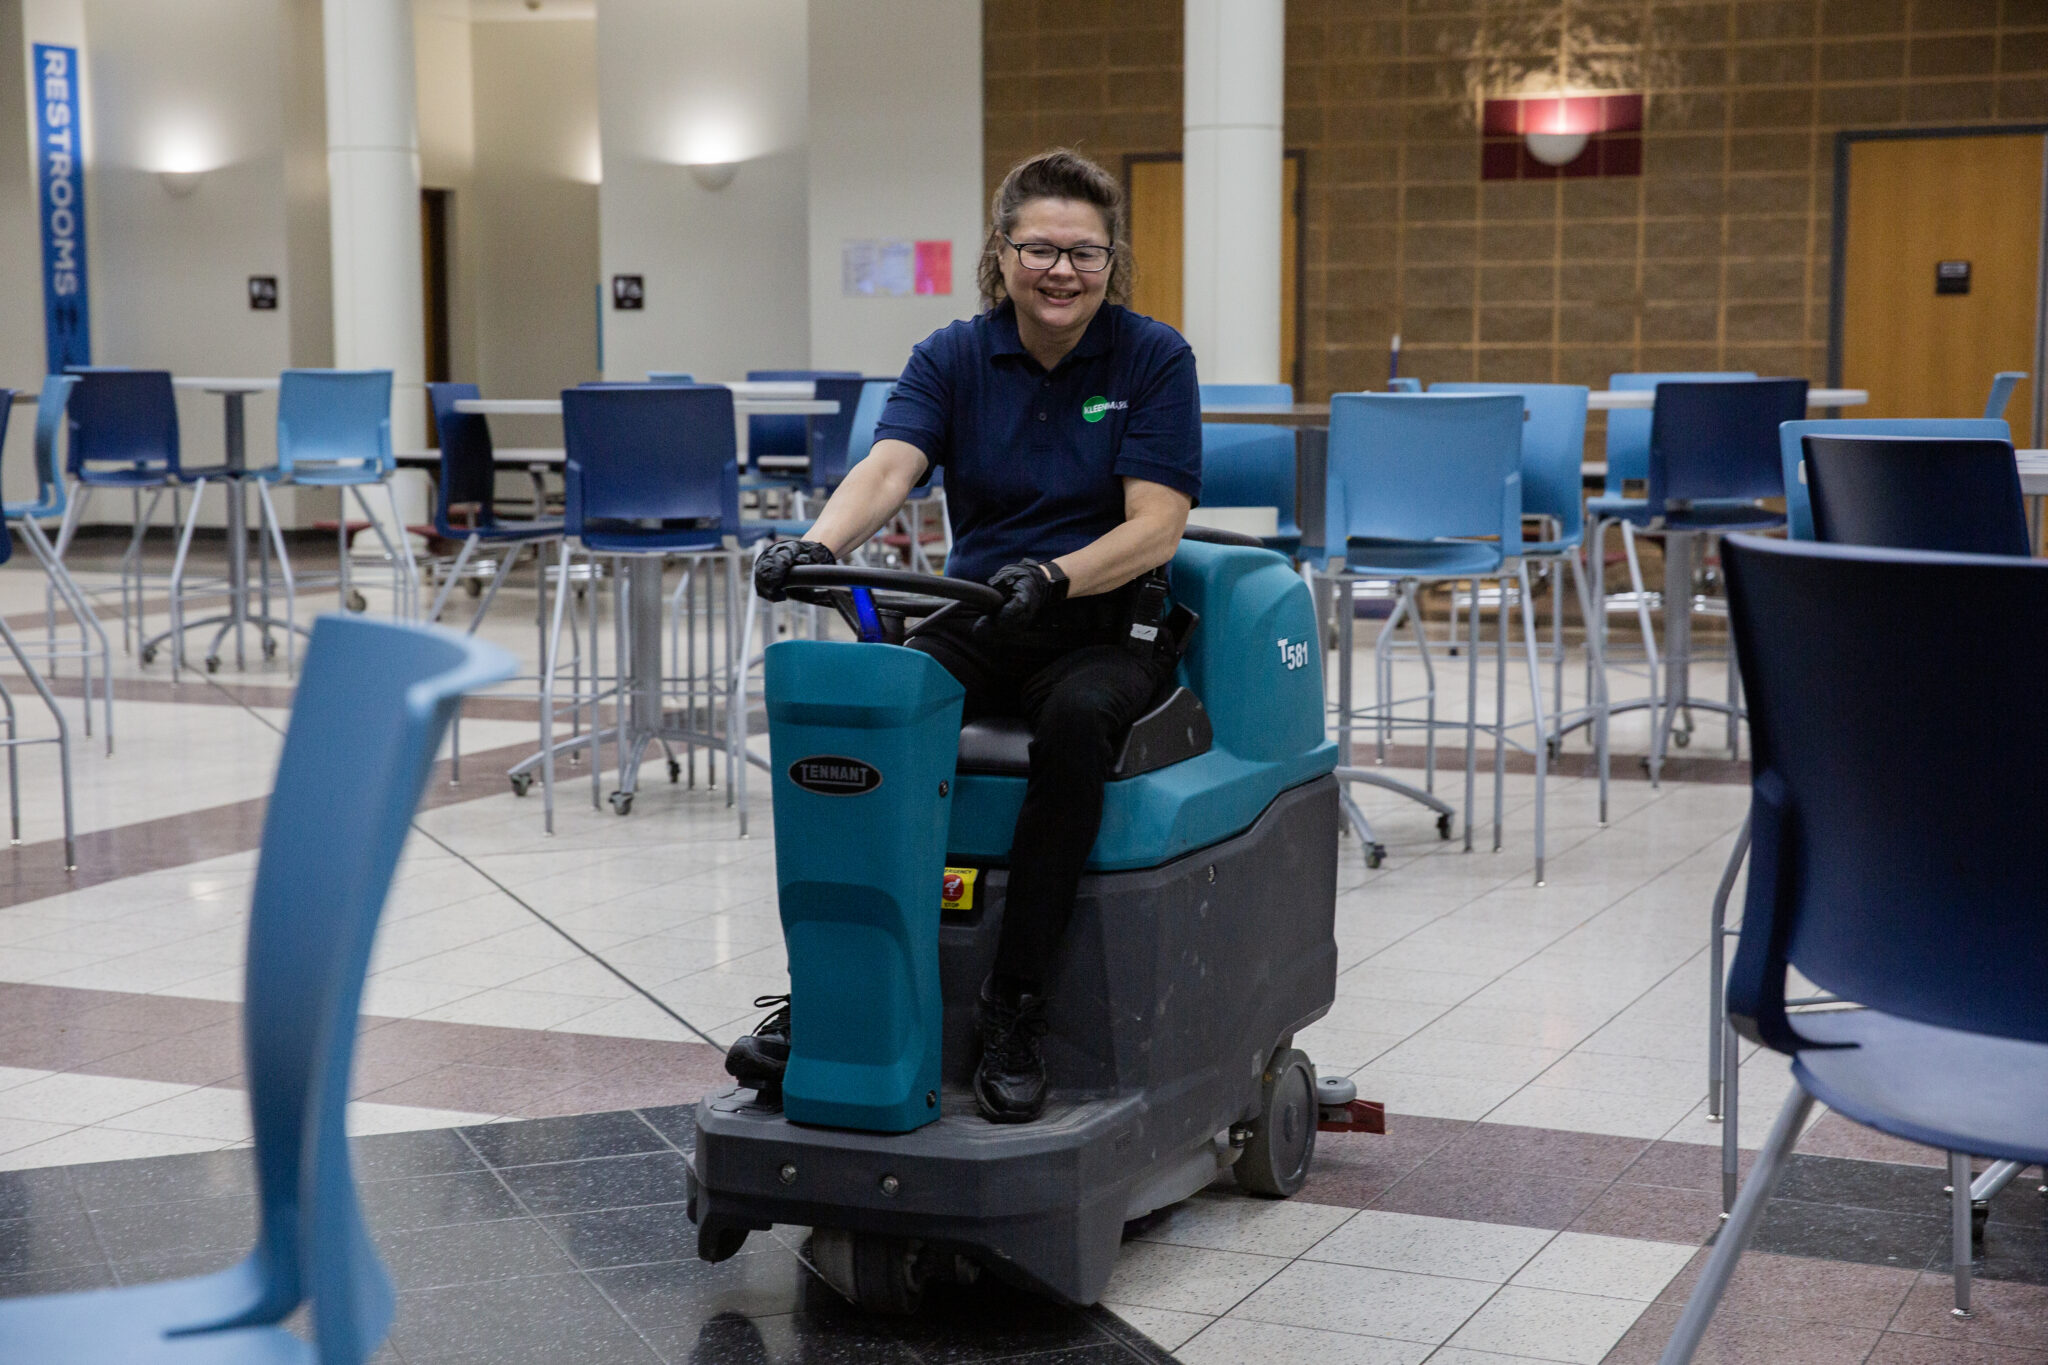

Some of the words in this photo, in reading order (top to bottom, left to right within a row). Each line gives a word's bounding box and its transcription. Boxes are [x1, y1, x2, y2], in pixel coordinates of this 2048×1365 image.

[43, 50, 77, 296] RESTROOMS
[1277, 638, 1308, 670] T581
[800, 764, 868, 787] TENNANT
